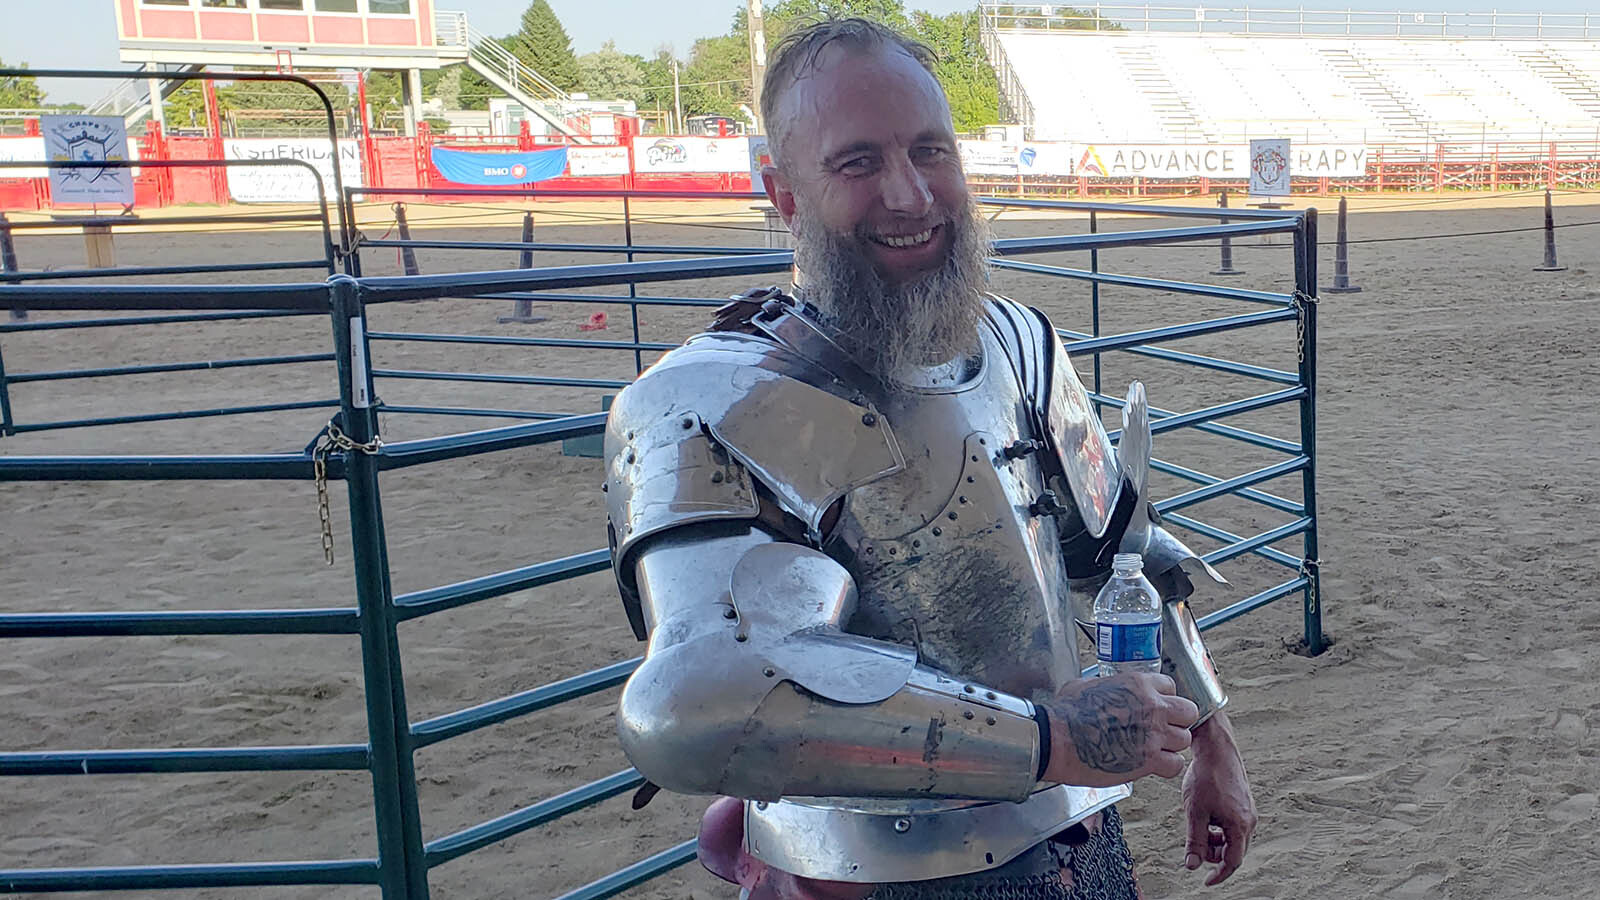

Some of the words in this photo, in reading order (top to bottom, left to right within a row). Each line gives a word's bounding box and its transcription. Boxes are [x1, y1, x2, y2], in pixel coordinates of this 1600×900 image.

[1112, 150, 1234, 172] ADVANCE
[1288, 149, 1364, 172] RAPY
[483, 167, 509, 176] BMO
